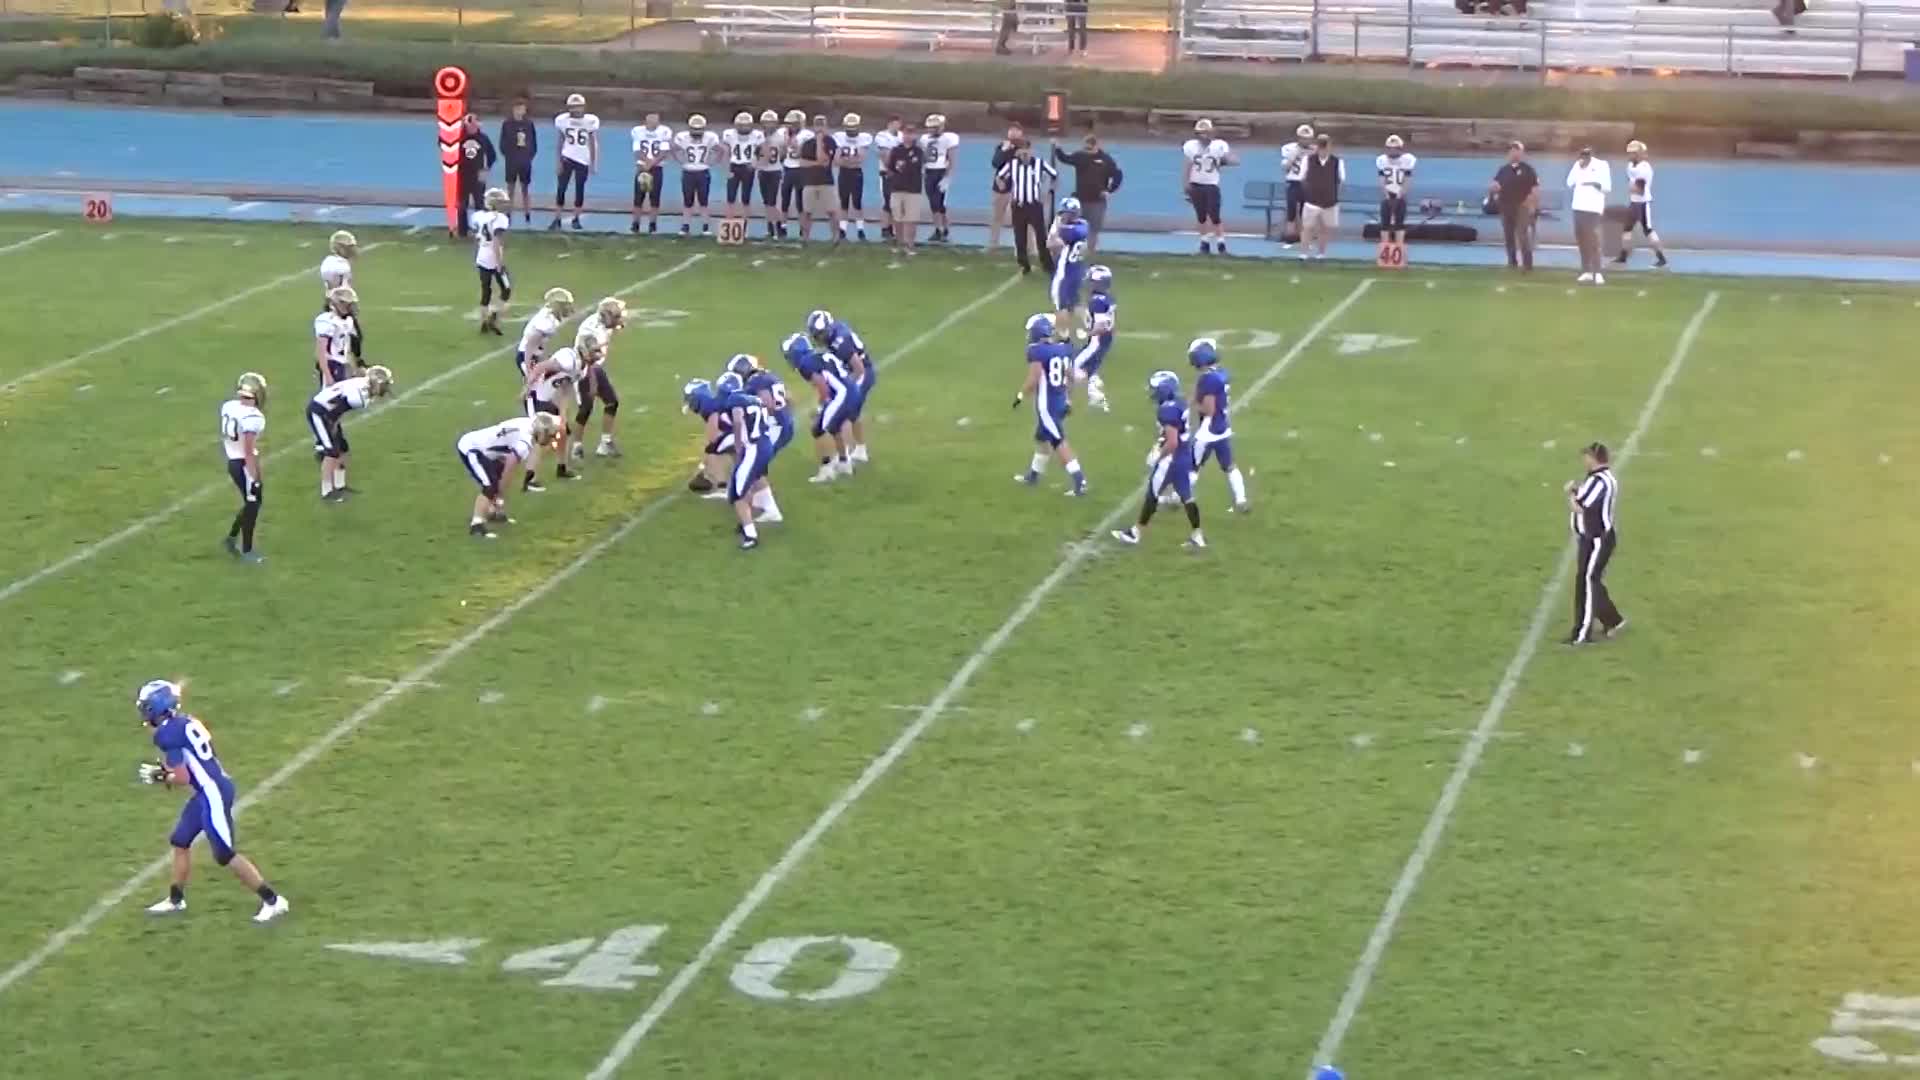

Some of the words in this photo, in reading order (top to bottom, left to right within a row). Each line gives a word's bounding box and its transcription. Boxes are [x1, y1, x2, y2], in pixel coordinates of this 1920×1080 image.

[565, 128, 589, 146] 56
[687, 145, 707, 163] 67
[733, 144, 752, 161] 44
[86, 199, 107, 218] 20
[720, 222, 742, 241] 30
[1379, 246, 1402, 264] 40
[501, 924, 900, 1000] 40
